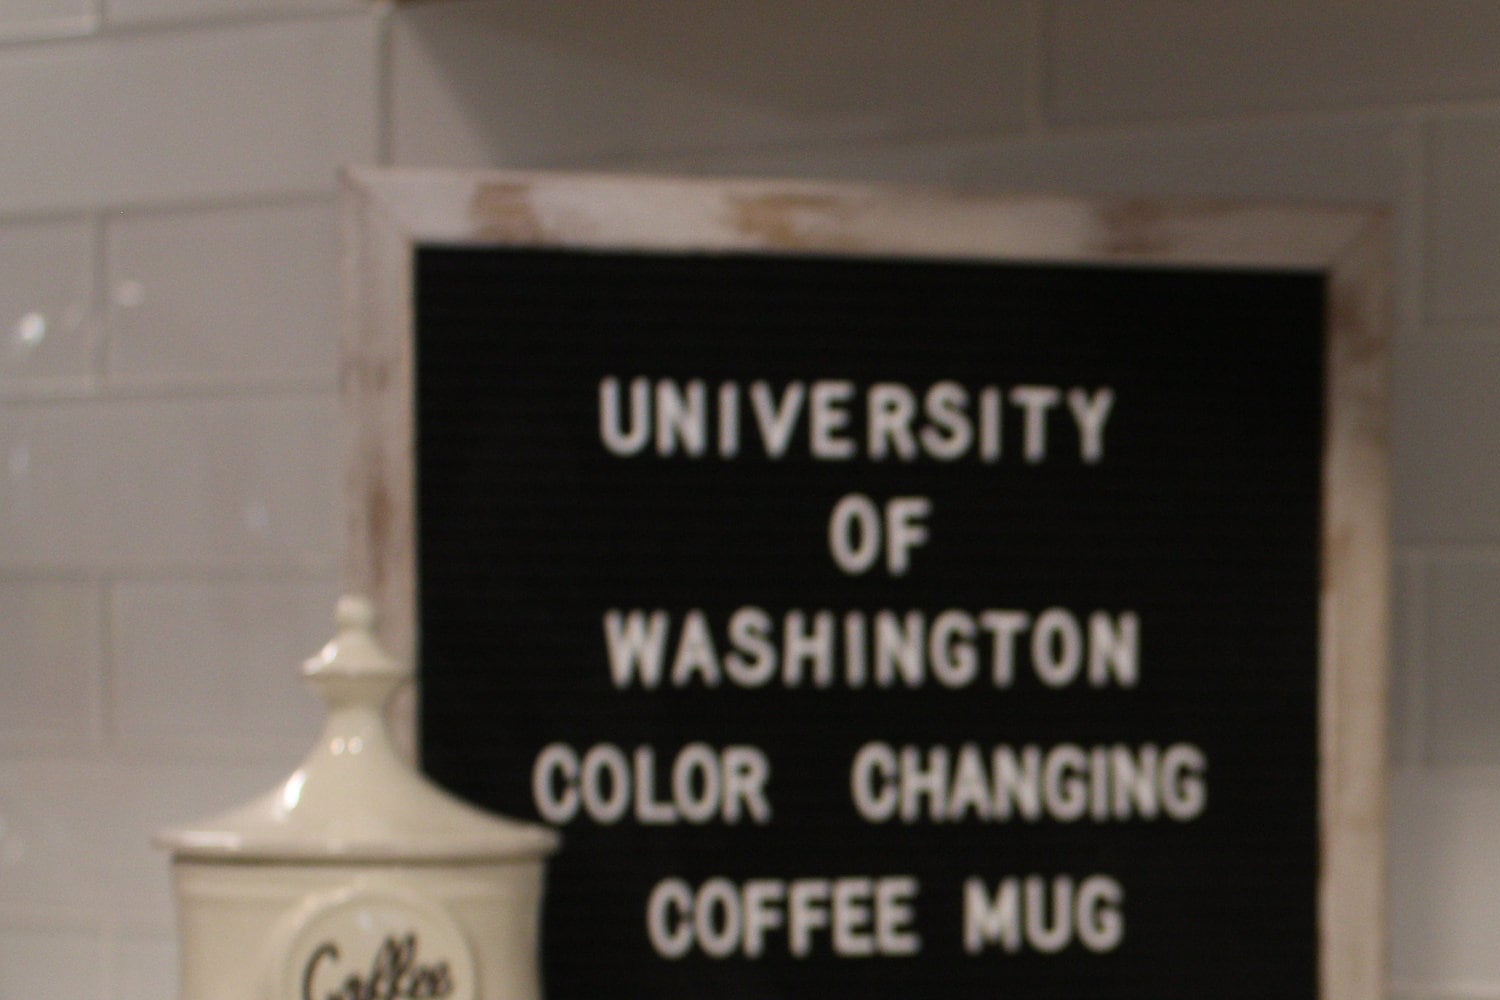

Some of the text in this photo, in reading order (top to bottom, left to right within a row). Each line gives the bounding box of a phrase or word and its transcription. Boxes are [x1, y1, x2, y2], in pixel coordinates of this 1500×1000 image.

[599, 378, 1112, 461] UNIVERSITY
[829, 494, 931, 575] OF
[604, 607, 1139, 688] WASHINGTON
[532, 742, 1206, 825] COLOR CHANGING
[646, 874, 1125, 958] COFFEE MUG
